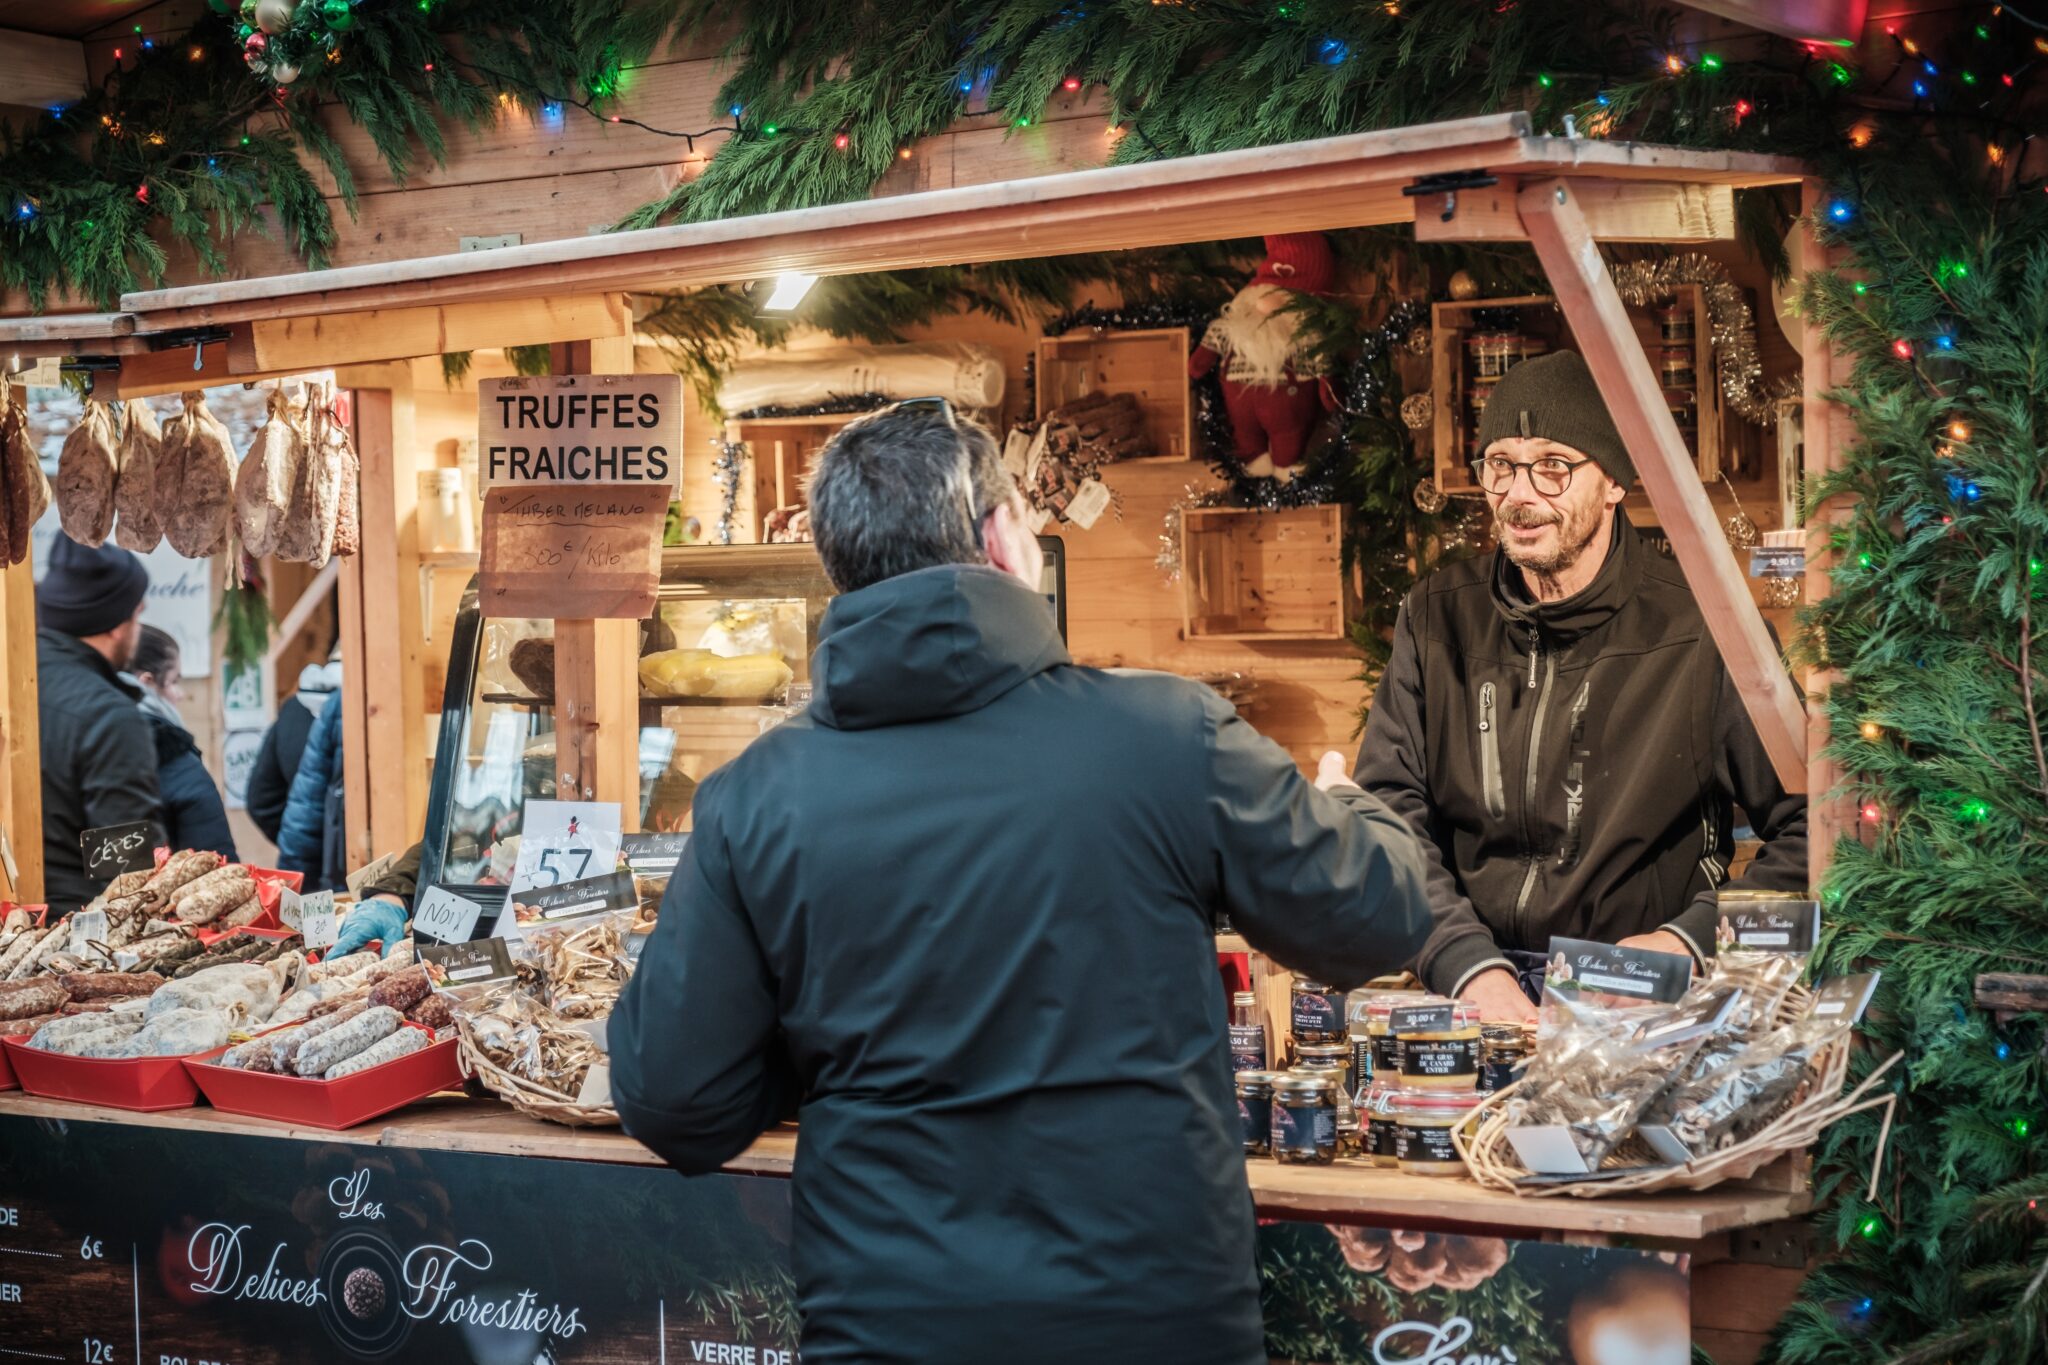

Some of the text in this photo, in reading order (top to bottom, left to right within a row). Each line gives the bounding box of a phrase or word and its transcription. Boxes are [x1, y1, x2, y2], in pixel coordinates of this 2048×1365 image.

[496, 393, 660, 429] TRUFFES
[489, 446, 669, 481] FRAICHES
[540, 848, 593, 885] 57
[423, 902, 469, 933] NOIX
[1425, 1066, 1449, 1074] ENTIER
[328, 1168, 385, 1219] Les
[80, 1235, 103, 1260] 6€
[187, 1222, 587, 1339] Delices Forestiers
[83, 1338, 114, 1364] 12€
[691, 1339, 792, 1365] VERRE DE
